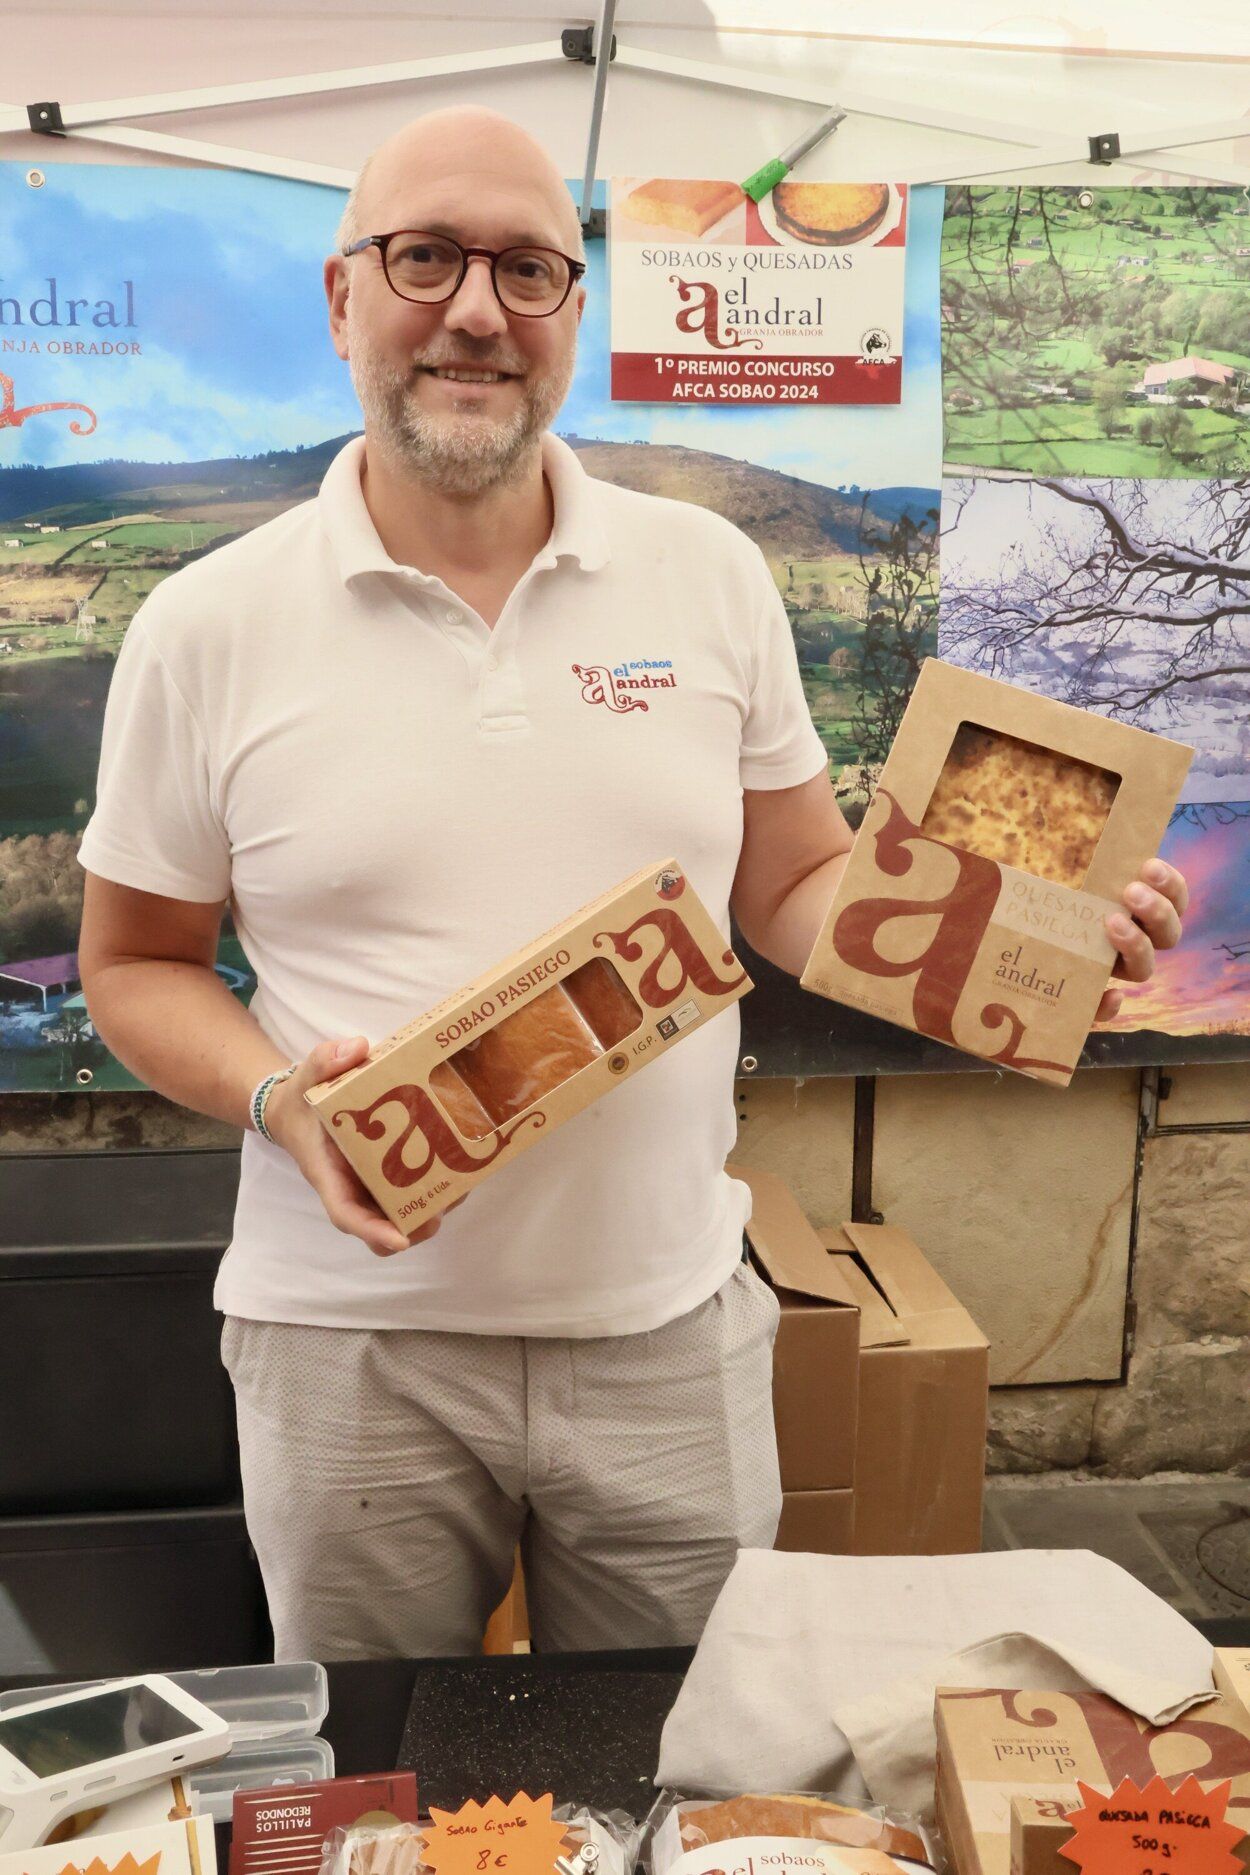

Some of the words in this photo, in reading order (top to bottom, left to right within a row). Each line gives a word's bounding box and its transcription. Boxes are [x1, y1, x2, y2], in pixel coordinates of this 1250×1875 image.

[641, 249, 722, 269] SOBAOS
[728, 256, 738, 272] y
[743, 252, 853, 272] QUESADAS
[724, 277, 748, 305] el
[726, 297, 824, 326] andral
[739, 328, 776, 336] GRANJA
[778, 328, 824, 337] OBRADOR
[47, 340, 143, 356] OBRADOR
[678, 360, 741, 376] PREMIO
[744, 361, 835, 377] CONCURSO
[672, 383, 719, 398] AFCA
[719, 383, 776, 398] SOBAO
[779, 384, 819, 399] 2024
[613, 663, 630, 677] el
[630, 658, 673, 670] sobaos
[616, 673, 677, 690] andral
[1006, 902, 1089, 944] PASIEGA
[1001, 945, 1023, 966] el
[995, 968, 1066, 999] andral
[434, 1000, 496, 1050] SOBAO
[496, 949, 572, 1008] PASIEGO
[427, 1191, 434, 1199] 6
[994, 1744, 1071, 1762] andral
[1055, 1757, 1076, 1775] el
[256, 1804, 312, 1822] REDONDOS
[256, 1816, 312, 1835] PALILLOS
[1132, 1834, 1159, 1851] 500
[476, 1849, 492, 1870] 8
[494, 1854, 508, 1868] €
[760, 1852, 826, 1868] sobaos
